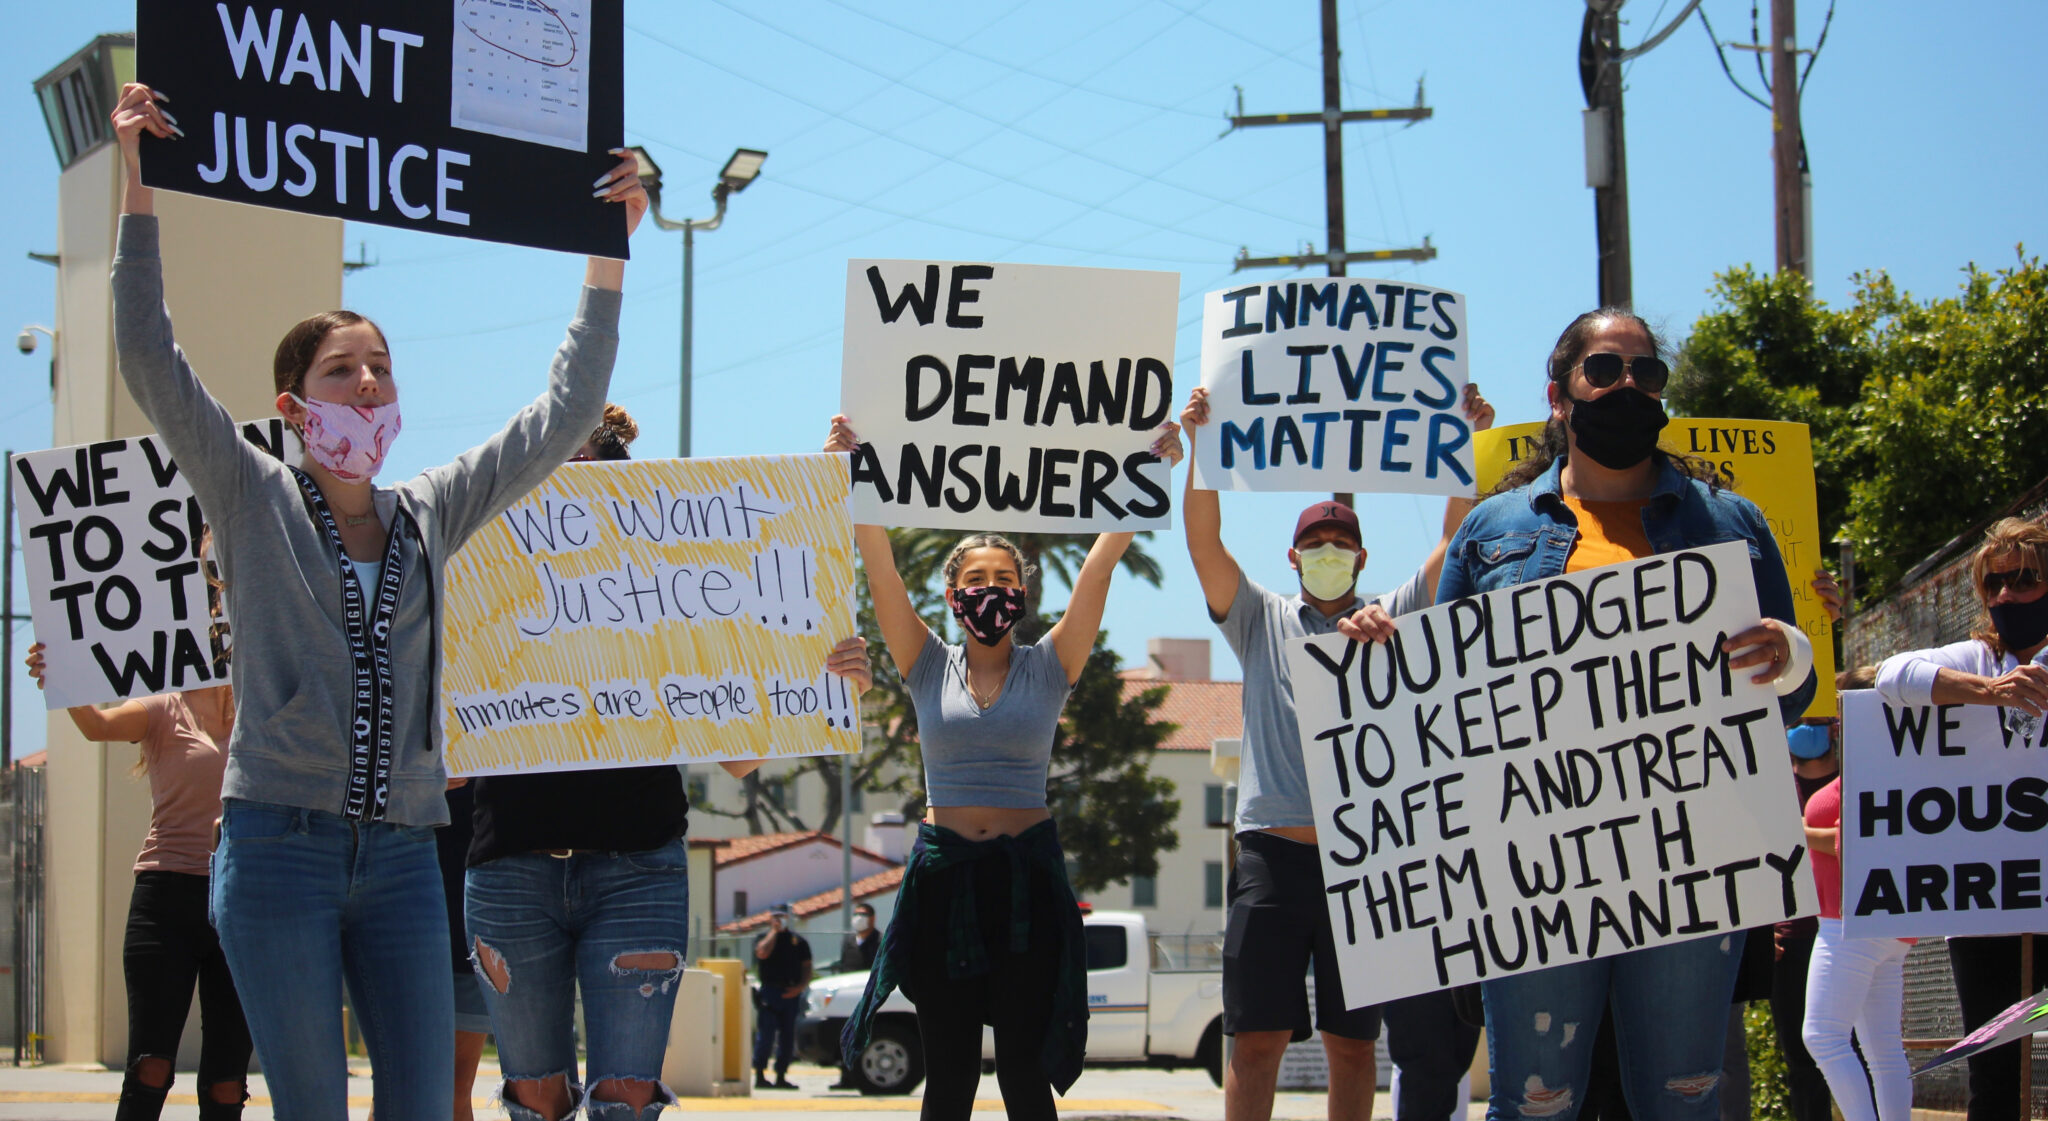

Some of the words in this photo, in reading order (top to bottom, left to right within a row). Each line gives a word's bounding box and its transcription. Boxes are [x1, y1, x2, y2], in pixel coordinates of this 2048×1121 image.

[217, 3, 424, 103] WANT
[197, 111, 471, 226] JUSTICE
[866, 265, 994, 328] WE
[1222, 283, 1457, 340] INMATES
[905, 354, 1172, 431] DEMAND
[1241, 342, 1457, 410] LIVES
[17, 440, 130, 516] WE
[1220, 409, 1473, 486] MATTER
[1688, 427, 1776, 455] LIVES
[852, 442, 1170, 520] ANSWERS
[30, 515, 124, 582] TO
[505, 500, 589, 554] We
[50, 574, 142, 641] TO
[345, 579, 367, 658] RELIGION
[1305, 613, 1441, 720] YOU
[1449, 551, 1718, 678] PLEDGED
[356, 667, 372, 709] TRUE
[376, 646, 392, 688] TRUE
[377, 695, 392, 778] RELIGION
[454, 690, 582, 733] inmates
[593, 691, 648, 718] are
[1315, 722, 1395, 798] TO
[1414, 666, 1564, 767] KEEP
[1571, 631, 1733, 730] THEM
[1882, 702, 1966, 756] WE
[1330, 772, 1470, 867] SAFE
[1499, 749, 1602, 823] AND
[1596, 708, 1769, 800] TREAT
[1326, 848, 1488, 945] THEM
[1508, 801, 1696, 898] WITH
[1854, 859, 2048, 916] ARRE
[1431, 845, 1806, 986] HUMANITY
